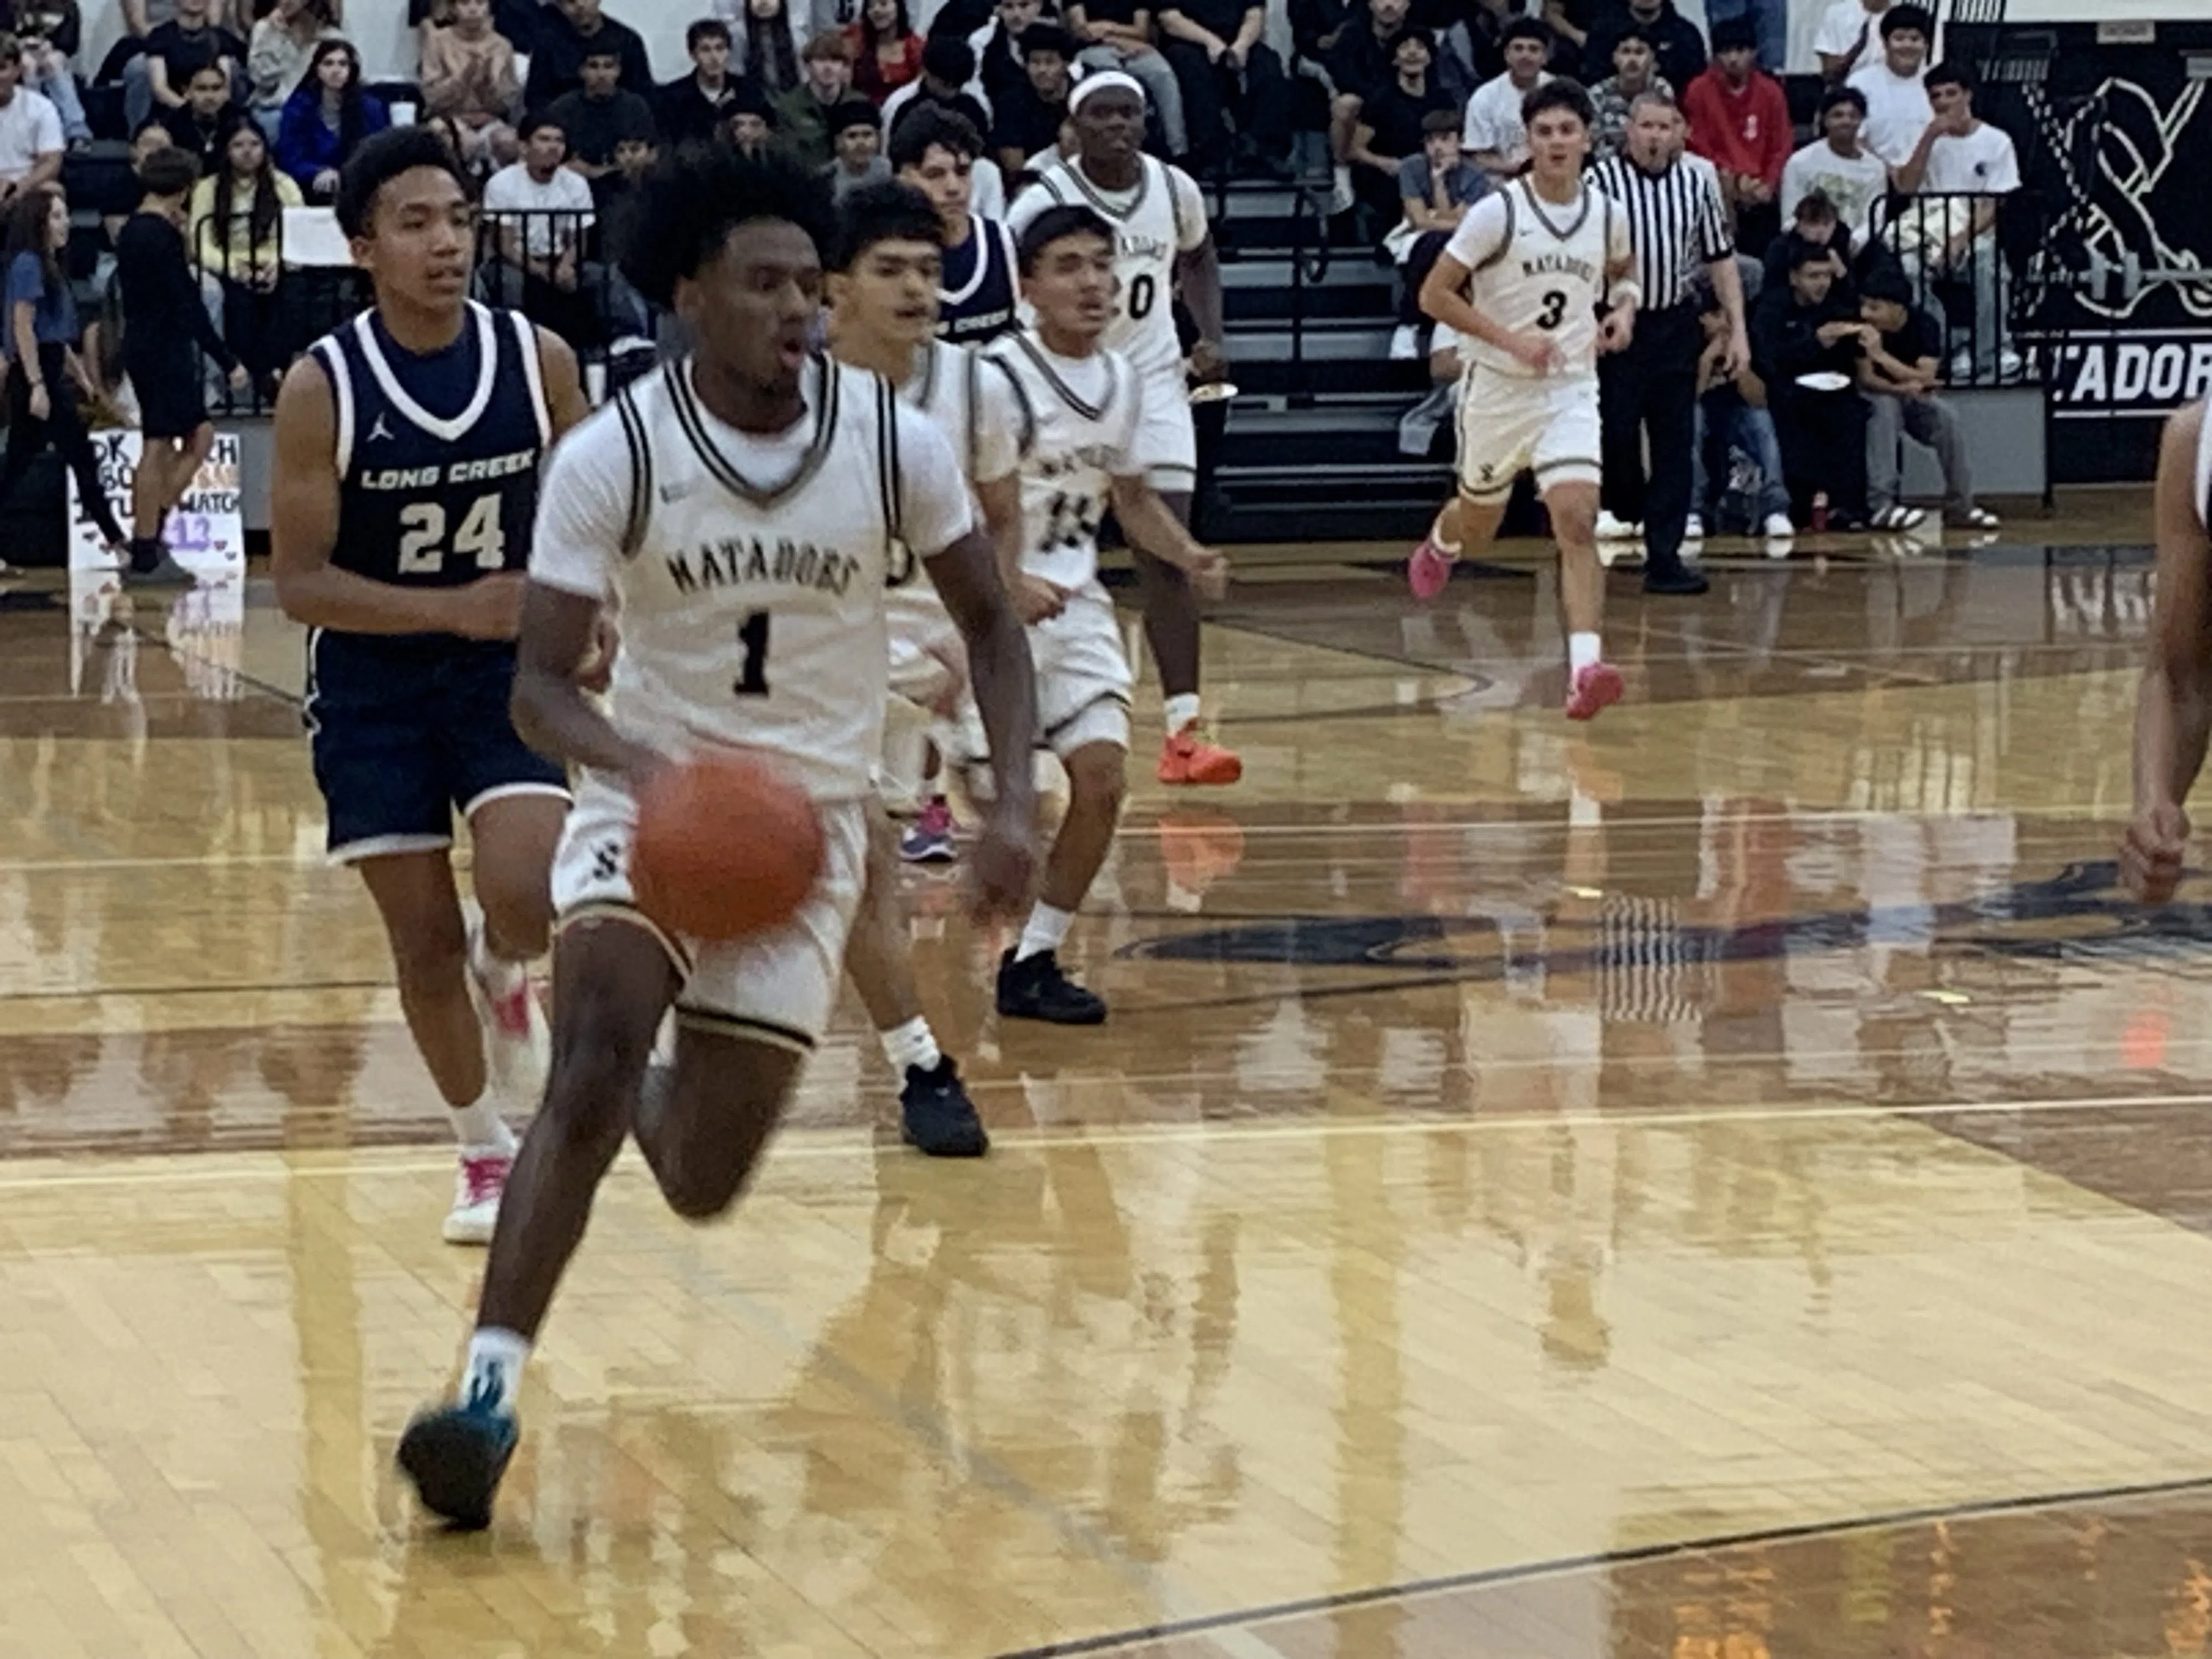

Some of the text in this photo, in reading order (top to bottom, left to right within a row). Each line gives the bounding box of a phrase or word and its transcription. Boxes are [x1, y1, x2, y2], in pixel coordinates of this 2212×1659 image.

[1129, 273, 1155, 320] 0
[1537, 290, 1568, 330] 3
[361, 447, 536, 491] LONG CREEK
[397, 492, 506, 574] 24
[734, 606, 770, 700] 1
